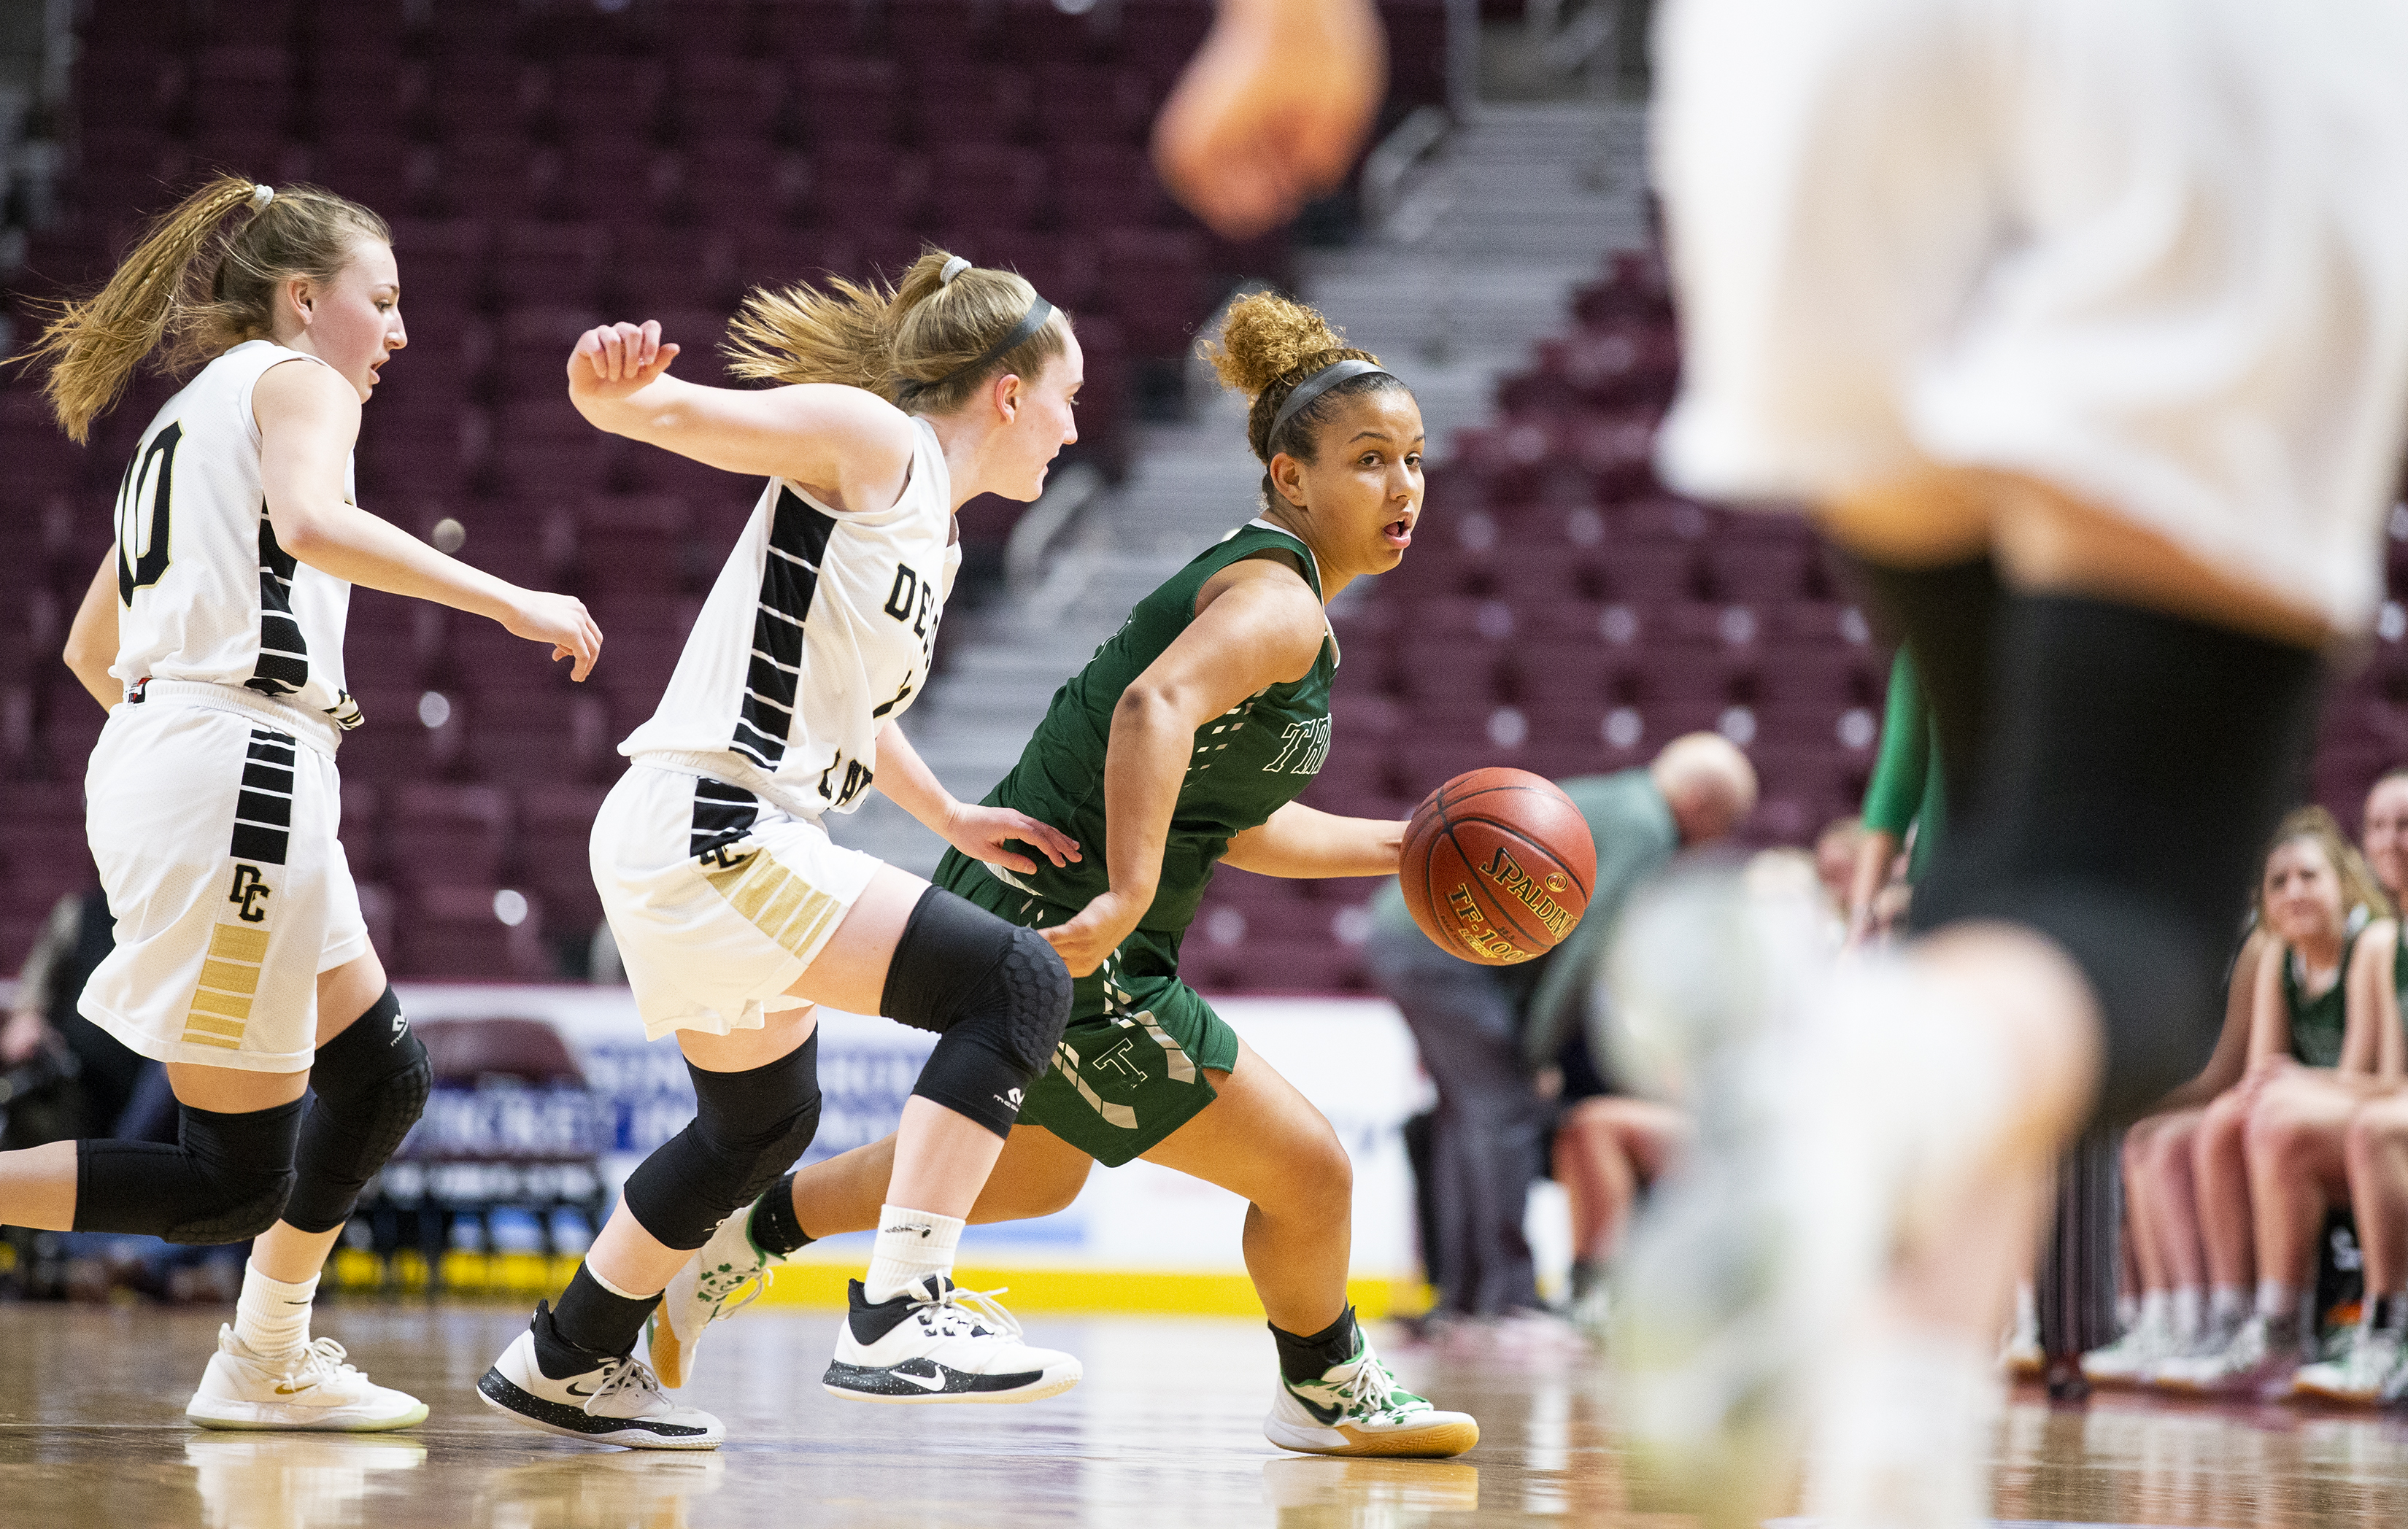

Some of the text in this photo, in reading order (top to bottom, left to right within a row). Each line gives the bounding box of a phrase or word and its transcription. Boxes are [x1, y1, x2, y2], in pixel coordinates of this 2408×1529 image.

[1262, 712, 1332, 775] TR
[229, 863, 272, 924] DC
[1449, 883, 1537, 963] TF-100
[1478, 846, 1578, 943] SPALDING
